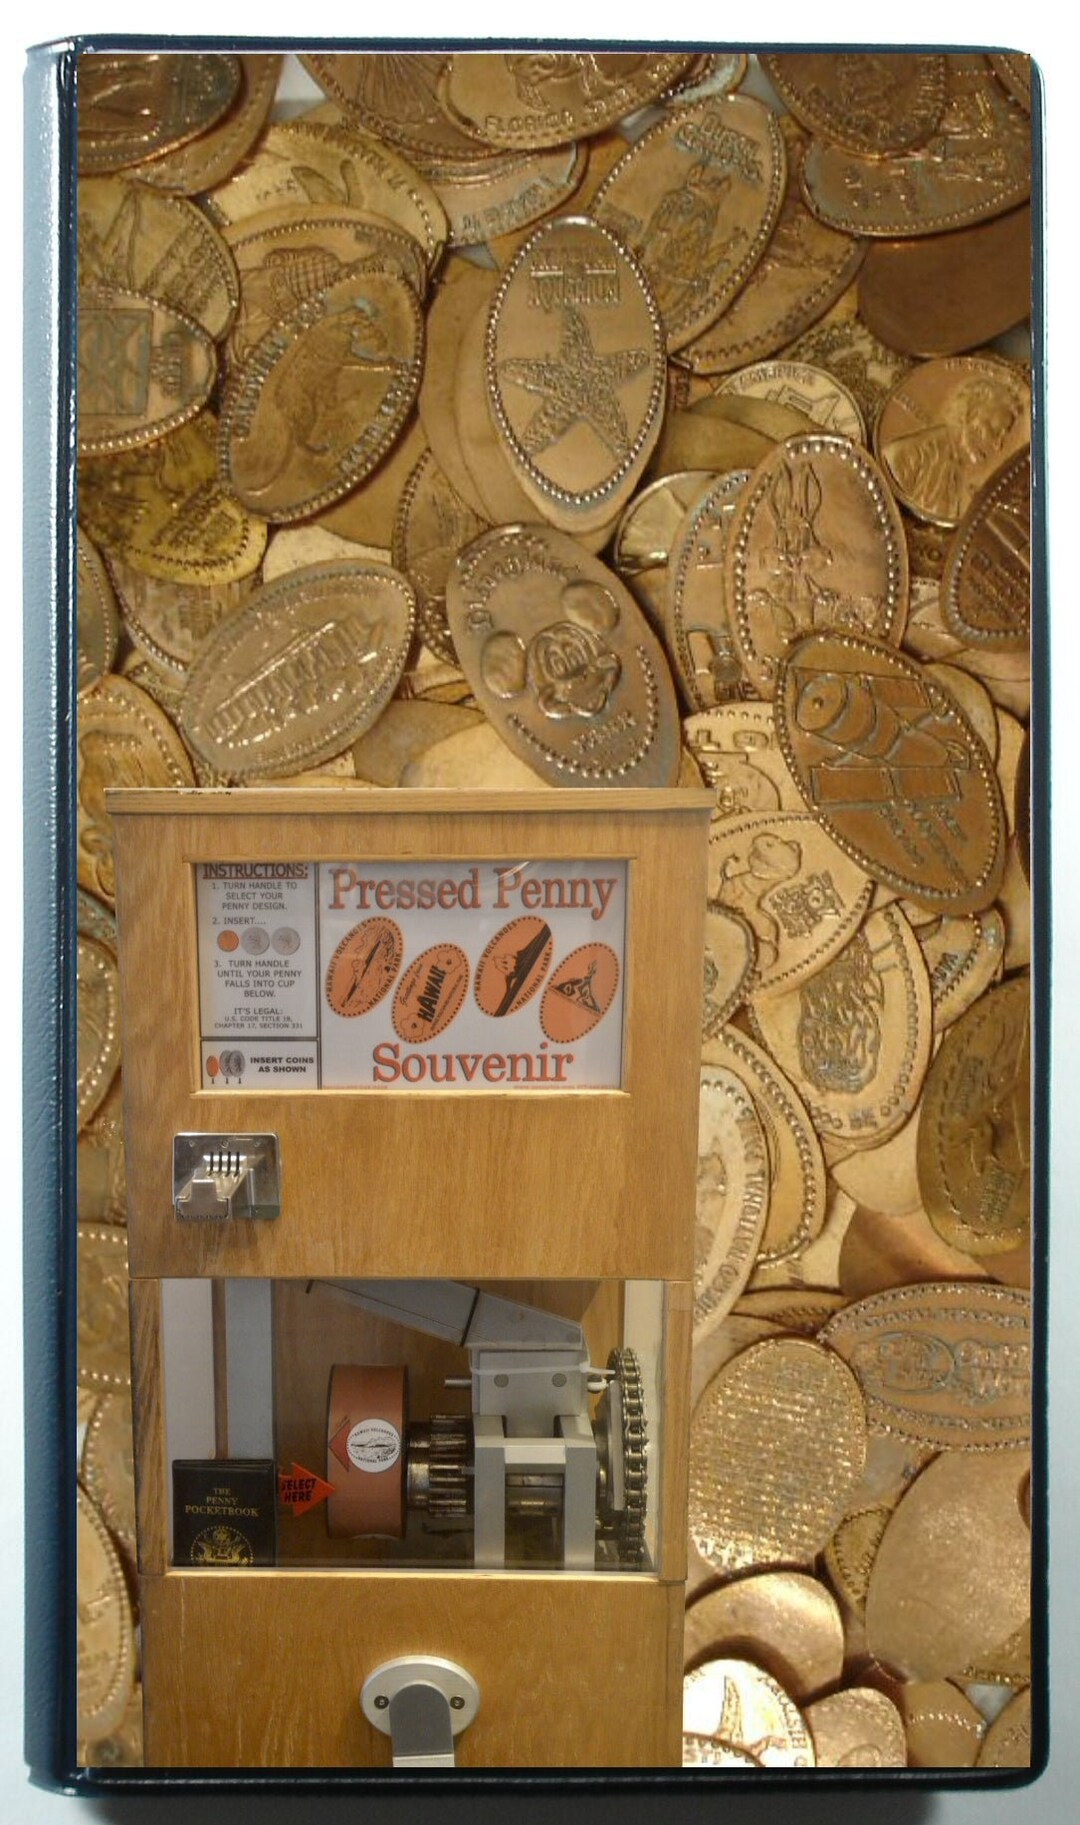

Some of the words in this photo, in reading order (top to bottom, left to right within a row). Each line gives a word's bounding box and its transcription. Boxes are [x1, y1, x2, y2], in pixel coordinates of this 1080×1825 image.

[203, 864, 308, 878] INSTRUCTIONS:
[212, 882, 219, 890] 1.
[223, 882, 246, 890] TURN
[249, 882, 282, 890] HANDLE
[286, 882, 297, 890] TO
[226, 892, 256, 900] SELECT
[260, 892, 283, 900] YOUR
[328, 867, 481, 910] Pressed
[493, 867, 618, 920] Penny
[212, 917, 220, 925] 2.
[475, 960, 486, 991] HAWAII
[484, 921, 518, 959] VOLCANOES
[214, 960, 222, 968] 3.
[229, 960, 252, 968] TURN
[255, 960, 290, 968] HANDLE
[217, 970, 243, 978] UNTIL
[247, 970, 270, 978] YOUR
[274, 970, 302, 978] PENNY
[225, 980, 250, 988] FALLS
[253, 980, 274, 988] INTO
[278, 980, 295, 988] CUP
[244, 990, 276, 998] BELOW.
[368, 975, 395, 1008] NATIONAL
[417, 964, 447, 1023] HAWAII
[516, 974, 545, 1007] NATIONAL
[372, 1041, 574, 1083] Souvenir
[214, 1487, 231, 1496] THE
[284, 1490, 313, 1503] HERE
[206, 1496, 240, 1506] PENNY
[185, 1504, 260, 1517] POCKETBOOK
